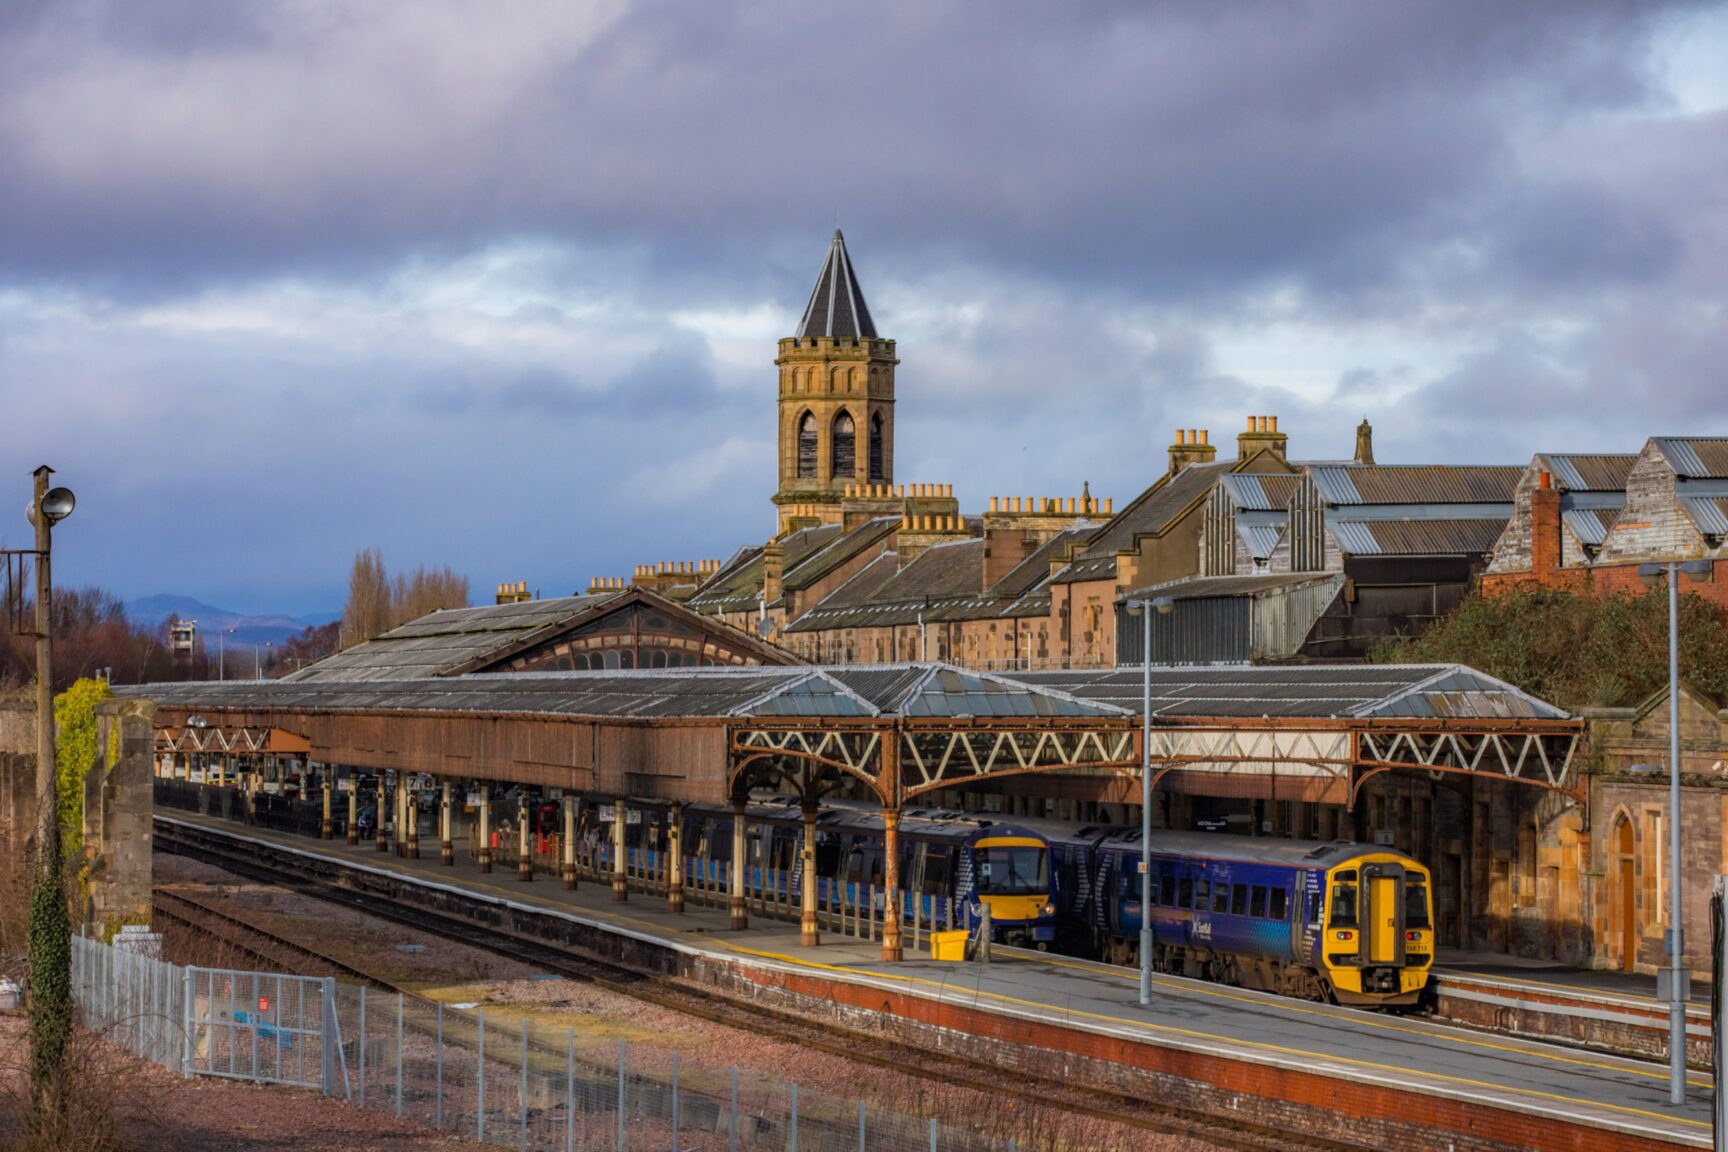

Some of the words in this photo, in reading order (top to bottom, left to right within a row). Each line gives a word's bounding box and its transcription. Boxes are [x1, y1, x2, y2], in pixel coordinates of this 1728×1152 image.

[410, 777, 416, 787] 7
[425, 778, 432, 788] 6
[1384, 834, 1390, 843] 5
